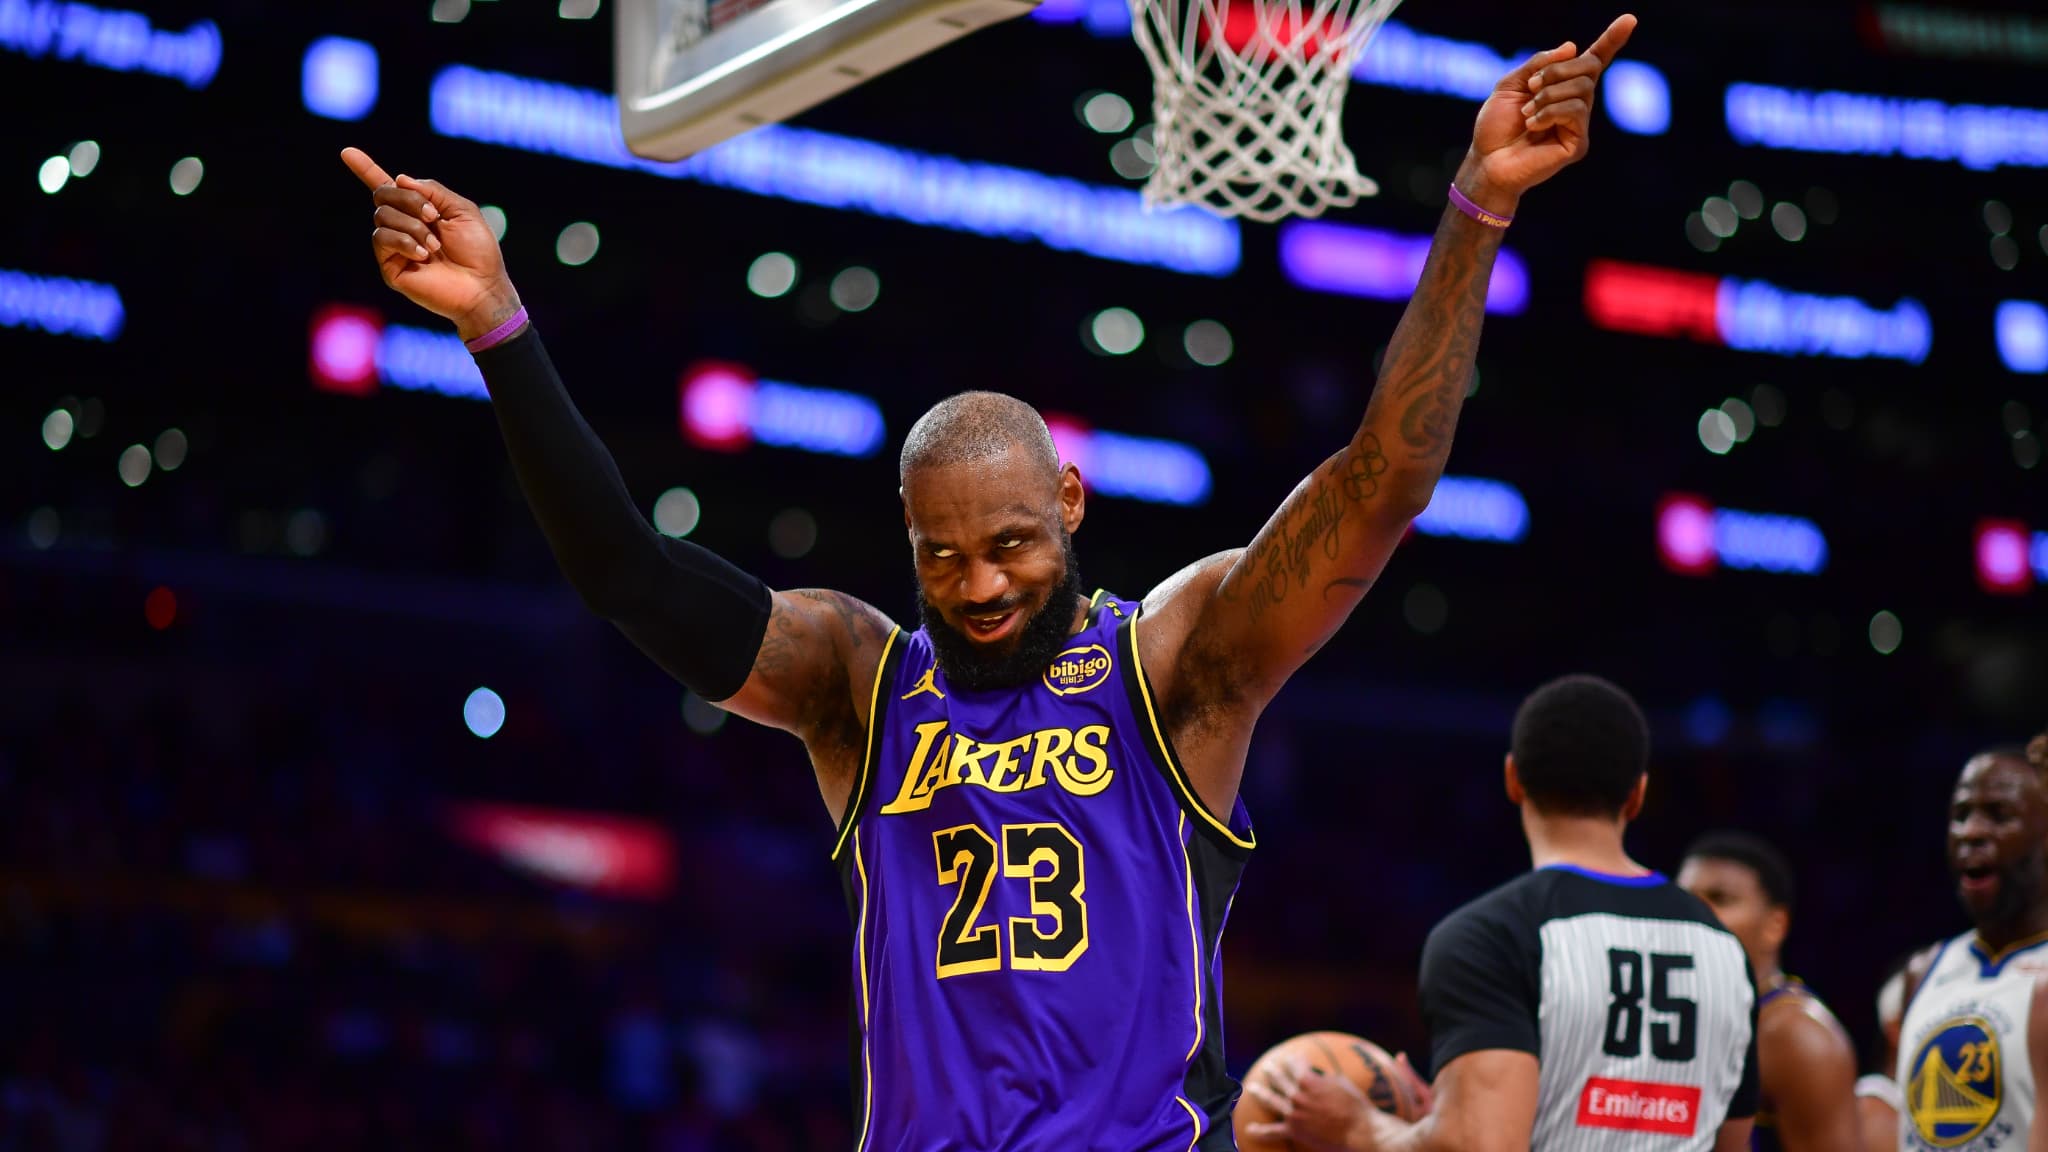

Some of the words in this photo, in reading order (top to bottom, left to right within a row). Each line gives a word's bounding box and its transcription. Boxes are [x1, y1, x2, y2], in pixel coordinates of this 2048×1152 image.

[1049, 657, 1107, 678] bibigo
[1060, 674, 1085, 685] 비비고
[932, 822, 1089, 980] 23
[1603, 947, 1697, 1063] 85
[1955, 1041, 1992, 1086] 23
[1588, 1086, 1689, 1124] Emirates
